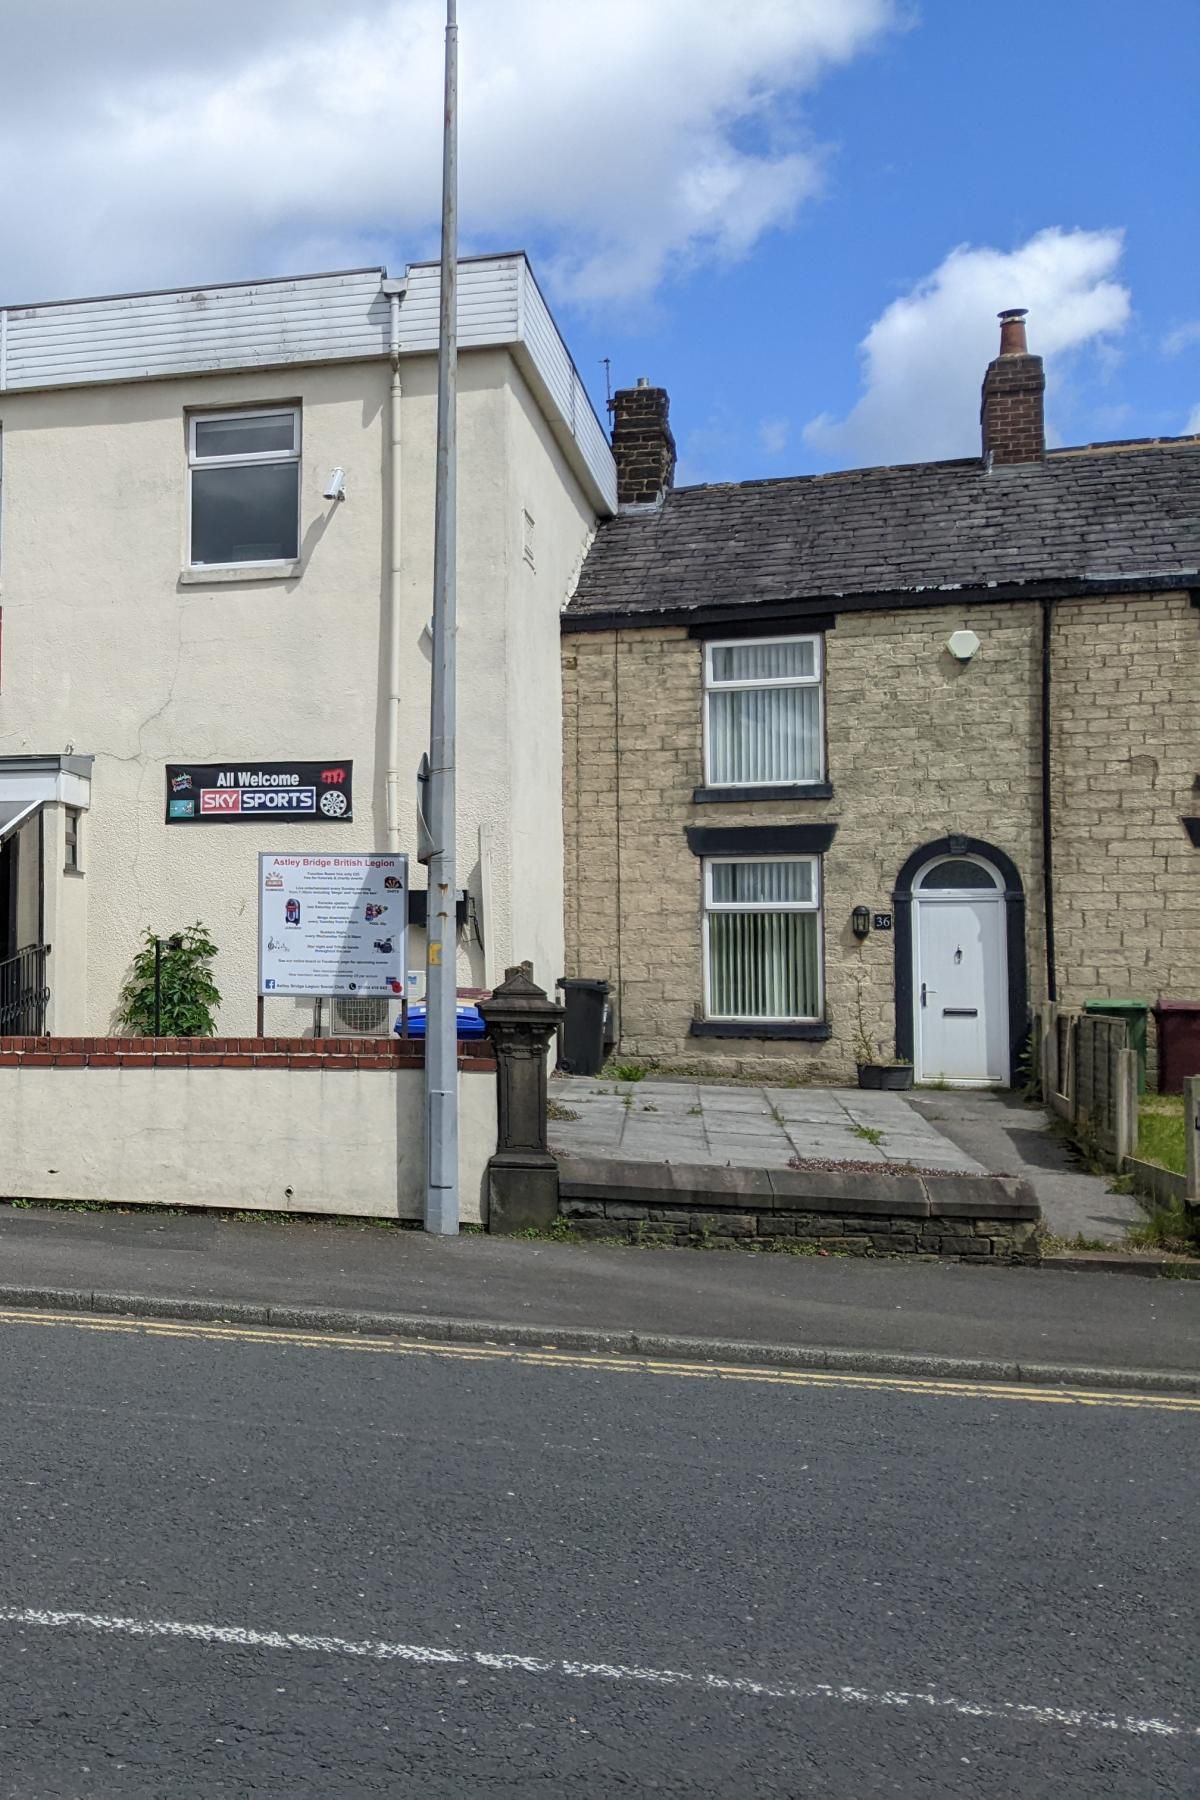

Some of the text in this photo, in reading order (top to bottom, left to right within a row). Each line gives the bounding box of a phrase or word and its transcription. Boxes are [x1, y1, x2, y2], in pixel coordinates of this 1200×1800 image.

[217, 771, 300, 787] All Welcome
[203, 792, 312, 808] SKY SPORTS
[273, 858, 395, 869] Astley Bridge British Legion
[876, 916, 890, 927] 36
